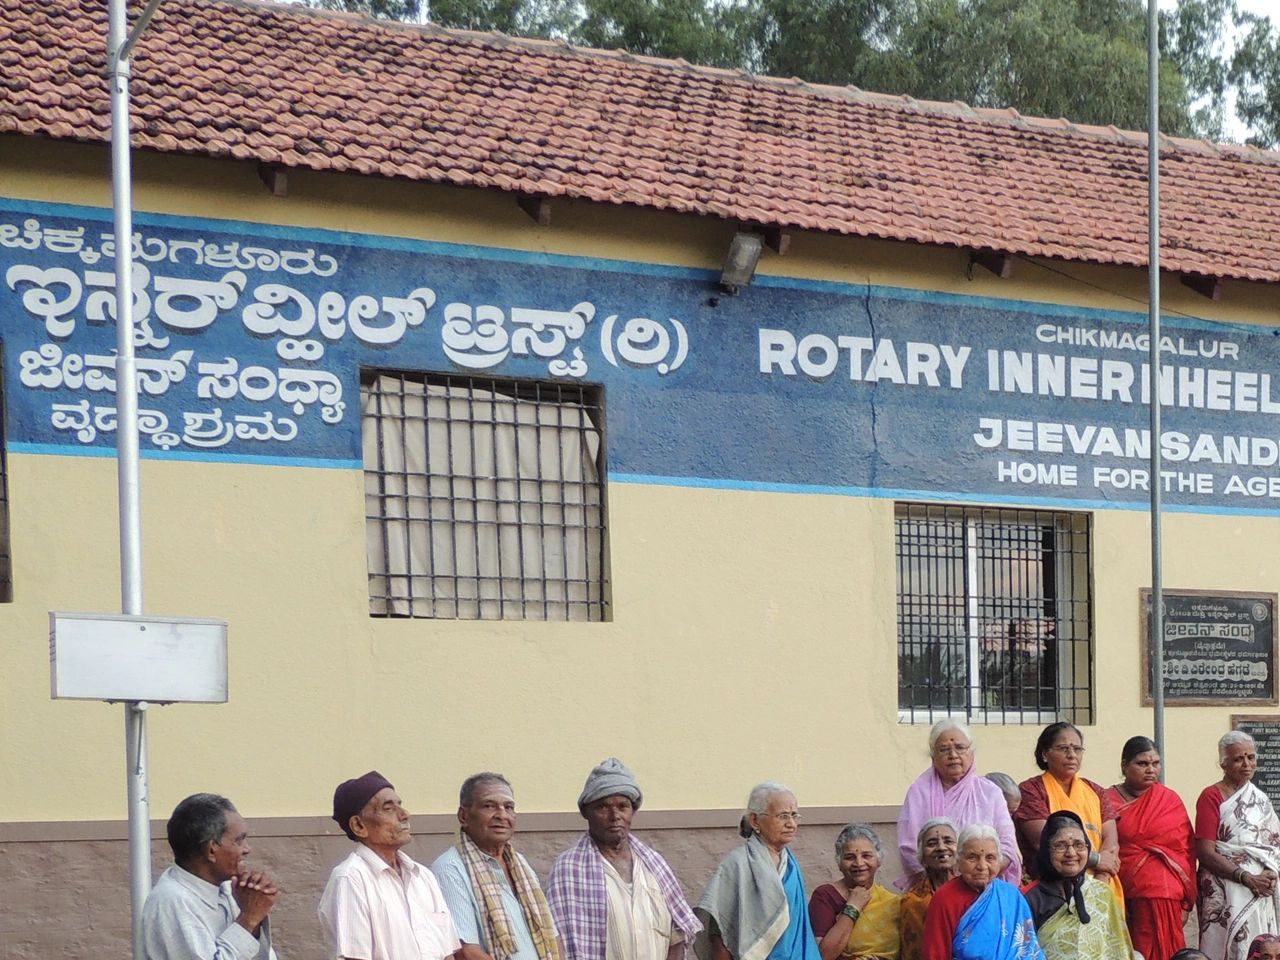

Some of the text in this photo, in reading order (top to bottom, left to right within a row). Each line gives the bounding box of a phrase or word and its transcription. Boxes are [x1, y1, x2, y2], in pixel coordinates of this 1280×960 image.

[1036, 324, 1240, 360] CHIKMAGALUR
[759, 328, 972, 389] ROTARY
[988, 350, 1134, 403] INNER
[197, 357, 346, 424] ಸಂಧ್ಯಾ
[973, 418, 1151, 459] JEEVAN
[998, 461, 1078, 486] HOME
[1094, 467, 1150, 490] FOR
[1160, 471, 1213, 494] THE
